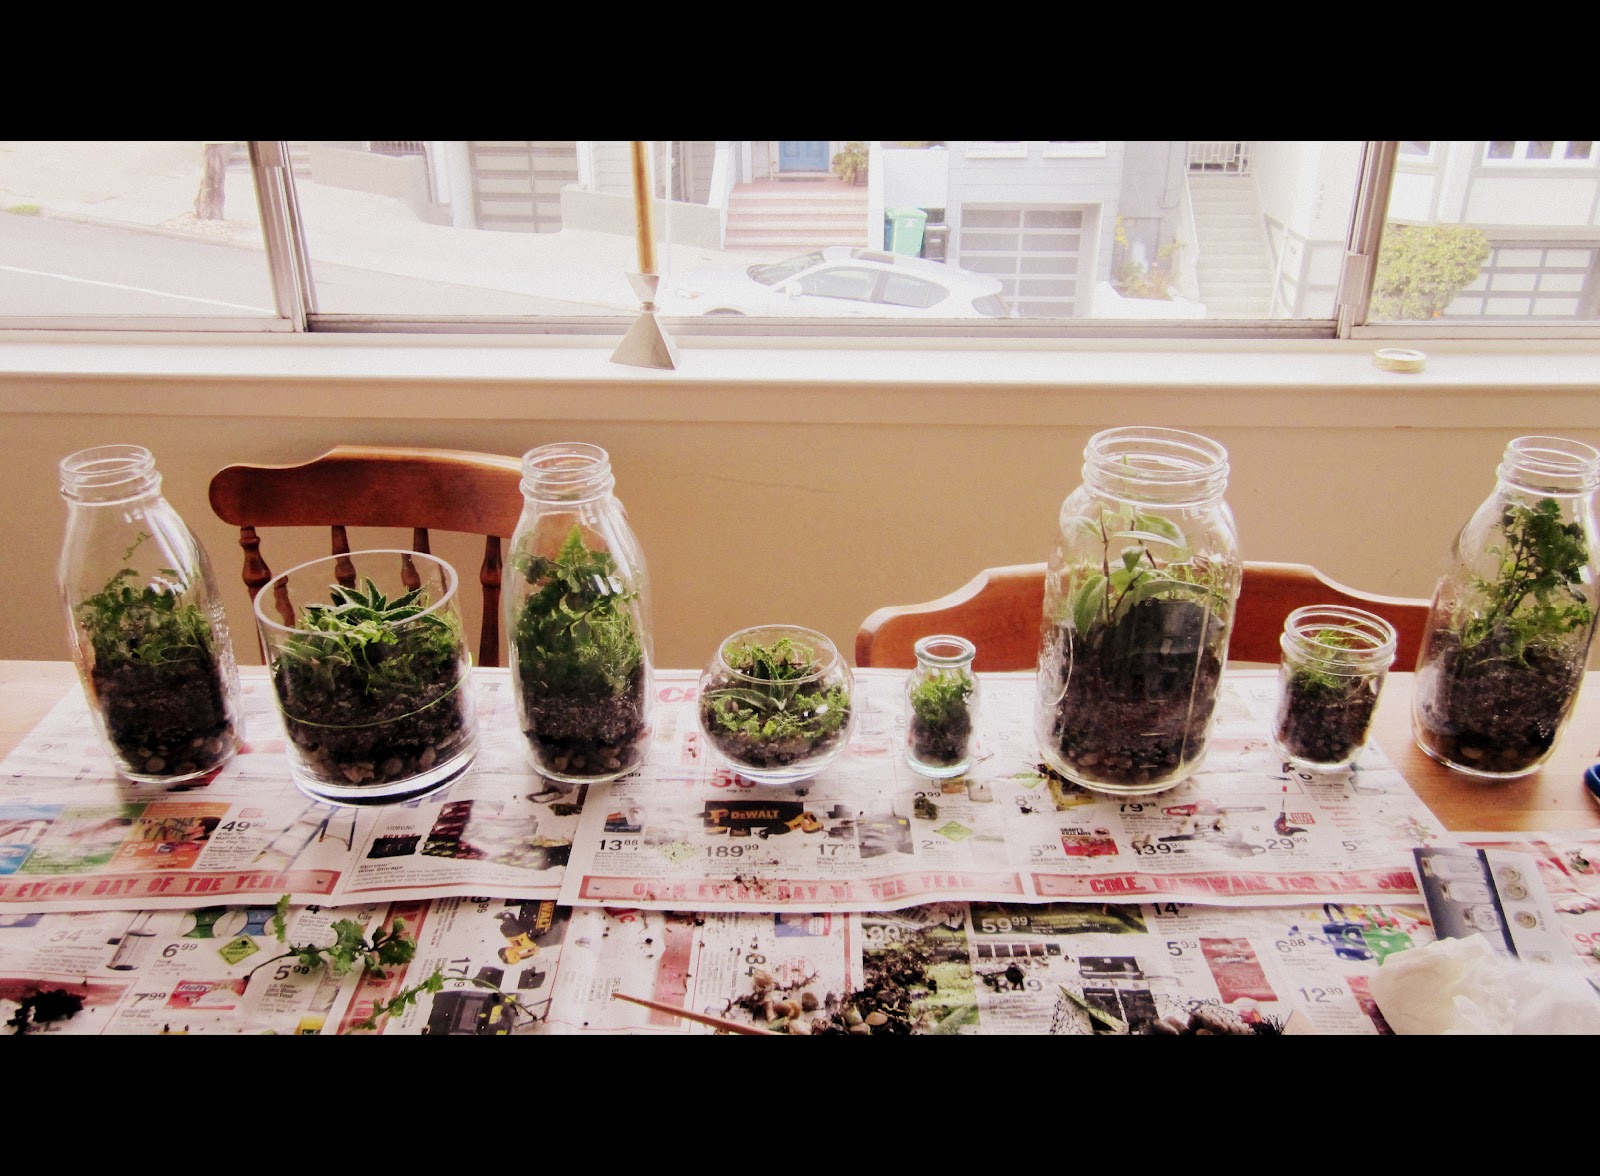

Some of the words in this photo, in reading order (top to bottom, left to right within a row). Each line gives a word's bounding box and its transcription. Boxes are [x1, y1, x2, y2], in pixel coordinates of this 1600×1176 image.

[598, 839, 638, 851] 1388
[705, 843, 759, 858] 18999
[92, 878, 140, 896] DAY
[147, 876, 175, 893] OF
[184, 876, 225, 892] THE
[234, 874, 288, 890] YEAR
[1276, 875, 1320, 891] FOR
[777, 886, 818, 900] DAY
[981, 916, 1029, 934] 5999
[162, 943, 198, 958] 699
[1166, 941, 1198, 957] 599
[1275, 938, 1306, 953] 688
[274, 964, 310, 981] 599
[130, 992, 167, 1008] 799
[1298, 986, 1344, 1003] 1299
